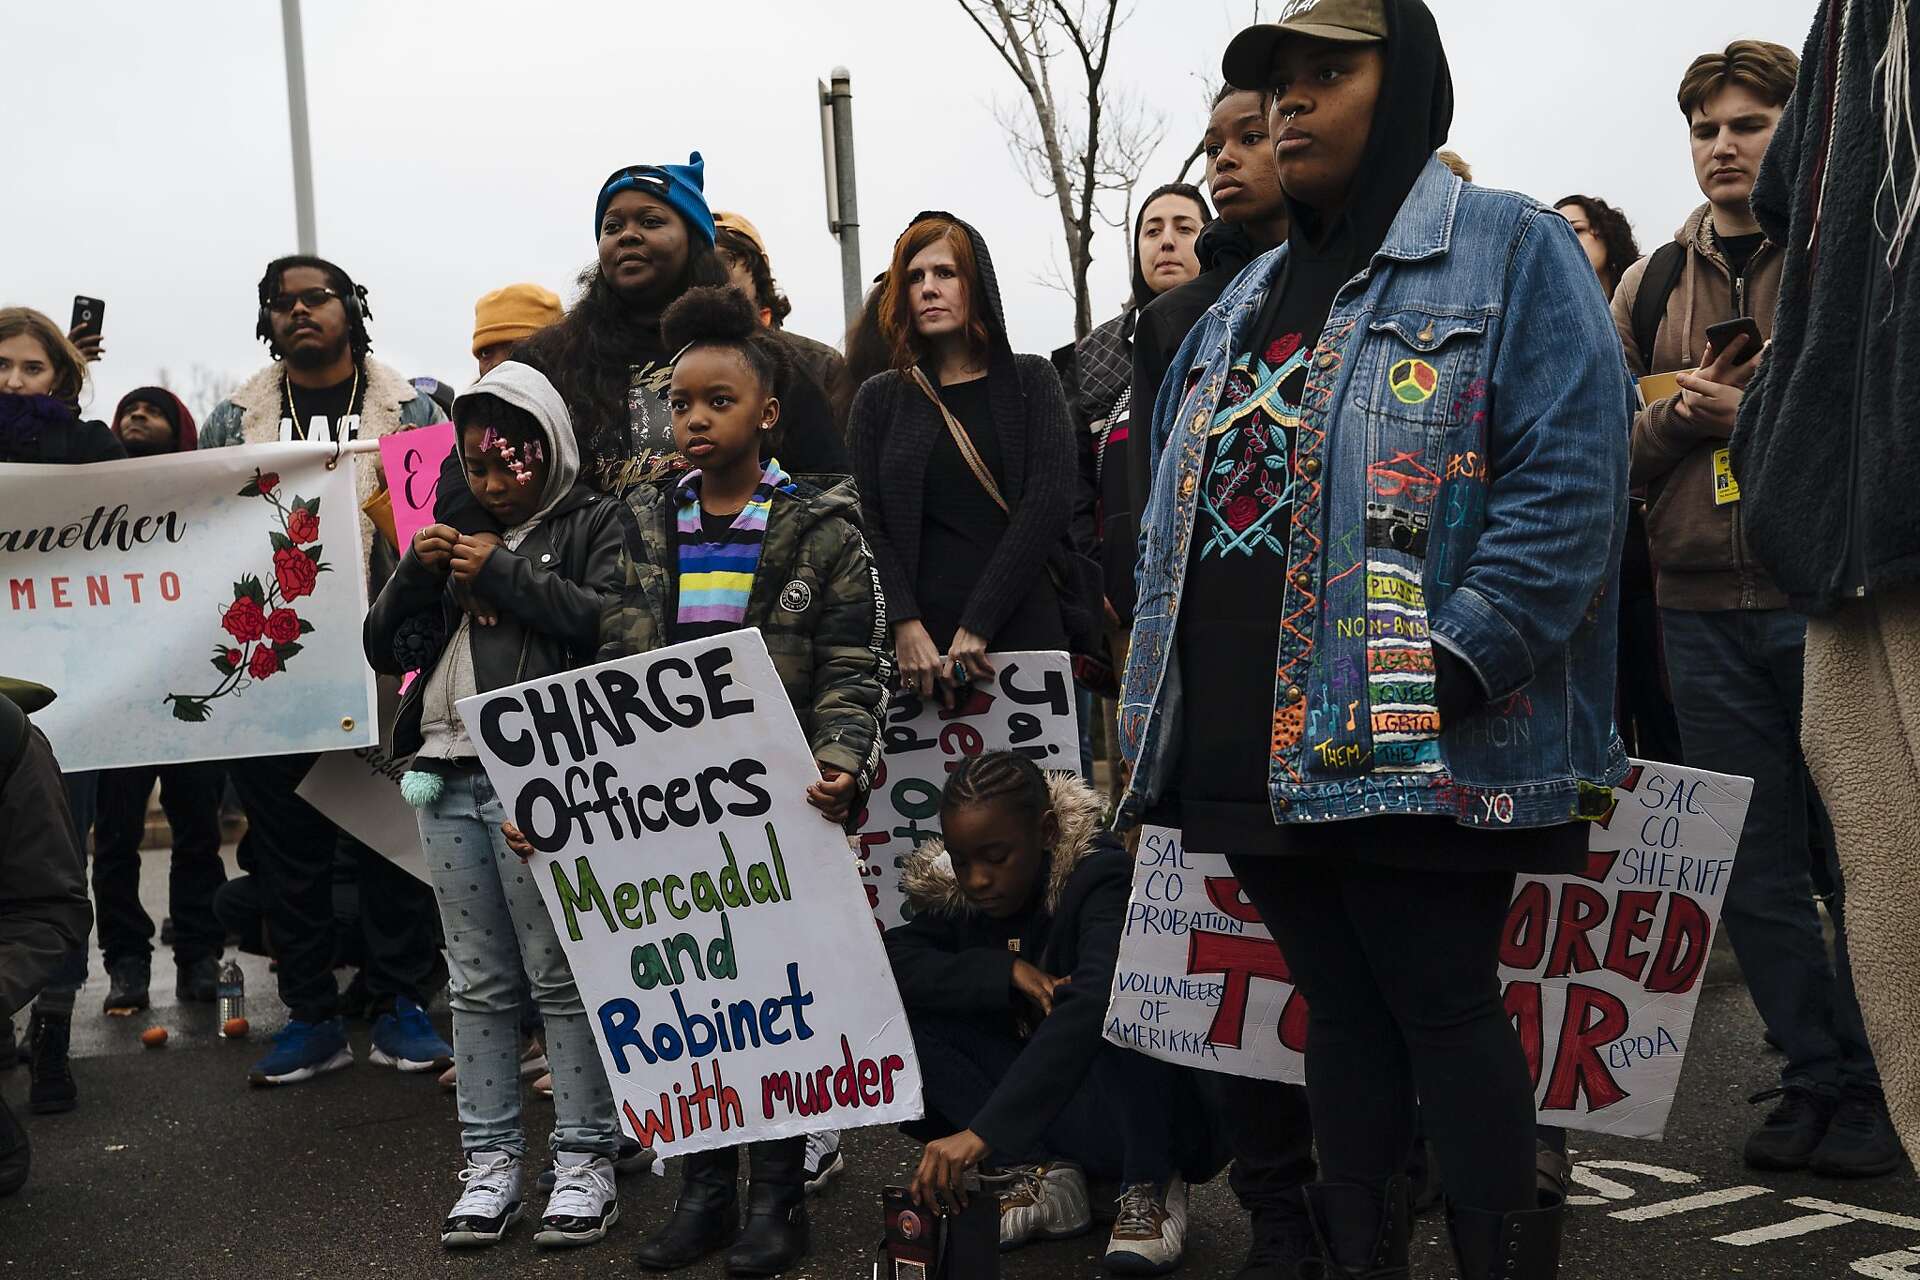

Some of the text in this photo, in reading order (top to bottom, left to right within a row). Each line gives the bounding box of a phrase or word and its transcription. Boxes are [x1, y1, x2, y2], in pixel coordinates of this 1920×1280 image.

[0, 503, 187, 552] another
[9, 571, 181, 610] MENTO
[479, 646, 755, 767] CHARGE
[514, 758, 772, 853] Officers
[549, 822, 792, 942] Mercadal
[1145, 871, 1183, 902] CO
[1616, 847, 1734, 896] SHERIFF
[1126, 902, 1243, 937] PROBATION
[630, 912, 738, 990] and
[1119, 972, 1224, 1007] VOLUNTEERS
[1139, 1000, 1170, 1024] OF
[597, 963, 815, 1074] Robinet
[1106, 1017, 1219, 1061] AMERIKKKA
[1608, 1026, 1679, 1069] CPOA
[623, 1033, 905, 1149] with murder
